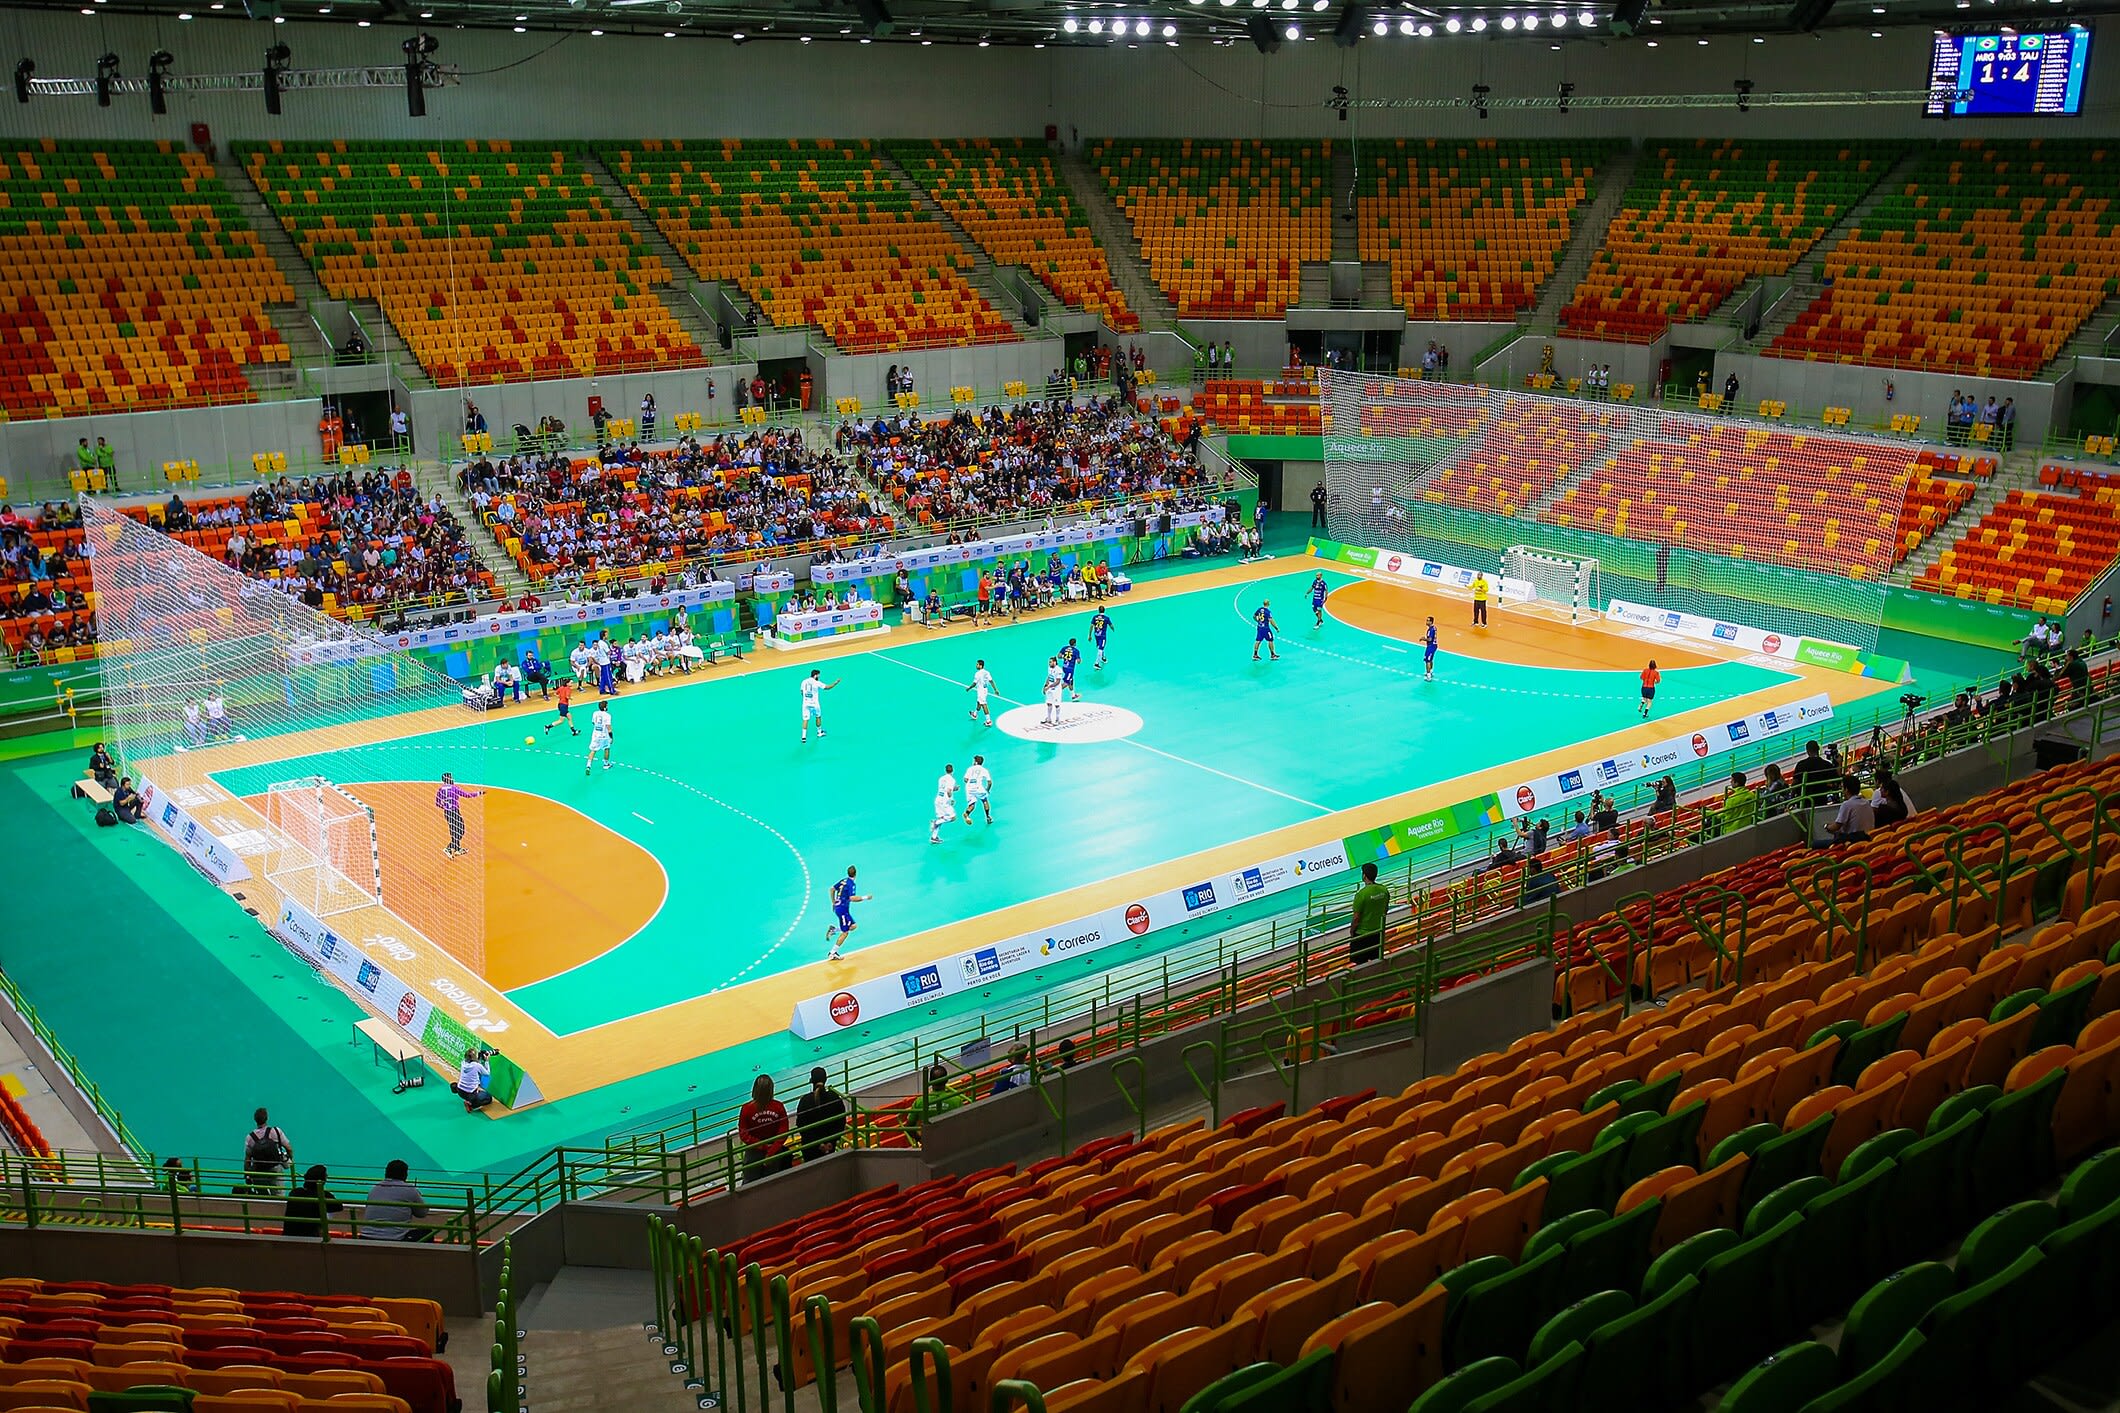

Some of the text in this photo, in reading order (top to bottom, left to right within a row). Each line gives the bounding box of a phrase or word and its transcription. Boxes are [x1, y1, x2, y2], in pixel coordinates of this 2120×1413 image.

[1975, 51, 2039, 62] MRG 9:03 TAU
[1980, 62, 1994, 83] 1
[2013, 62, 2030, 82] 4
[1622, 610, 1650, 622] Correios
[1063, 652, 1073, 661] 25
[1806, 647, 1843, 660] Aquece Rio
[1807, 704, 1830, 718] Correios
[1651, 751, 1677, 766] Correios
[1570, 776, 1581, 786] RIO
[1518, 794, 1533, 805] Claro
[1407, 818, 1445, 837] Aquece Rio
[1308, 854, 1343, 872] Correios
[1198, 888, 1213, 901] RIO
[1127, 913, 1146, 926] Claro
[1057, 931, 1101, 951] Correios
[920, 972, 938, 987] RIO
[430, 978, 489, 1018] Correios
[908, 996, 924, 1007] CIDADE
[831, 1001, 854, 1017] Claro
